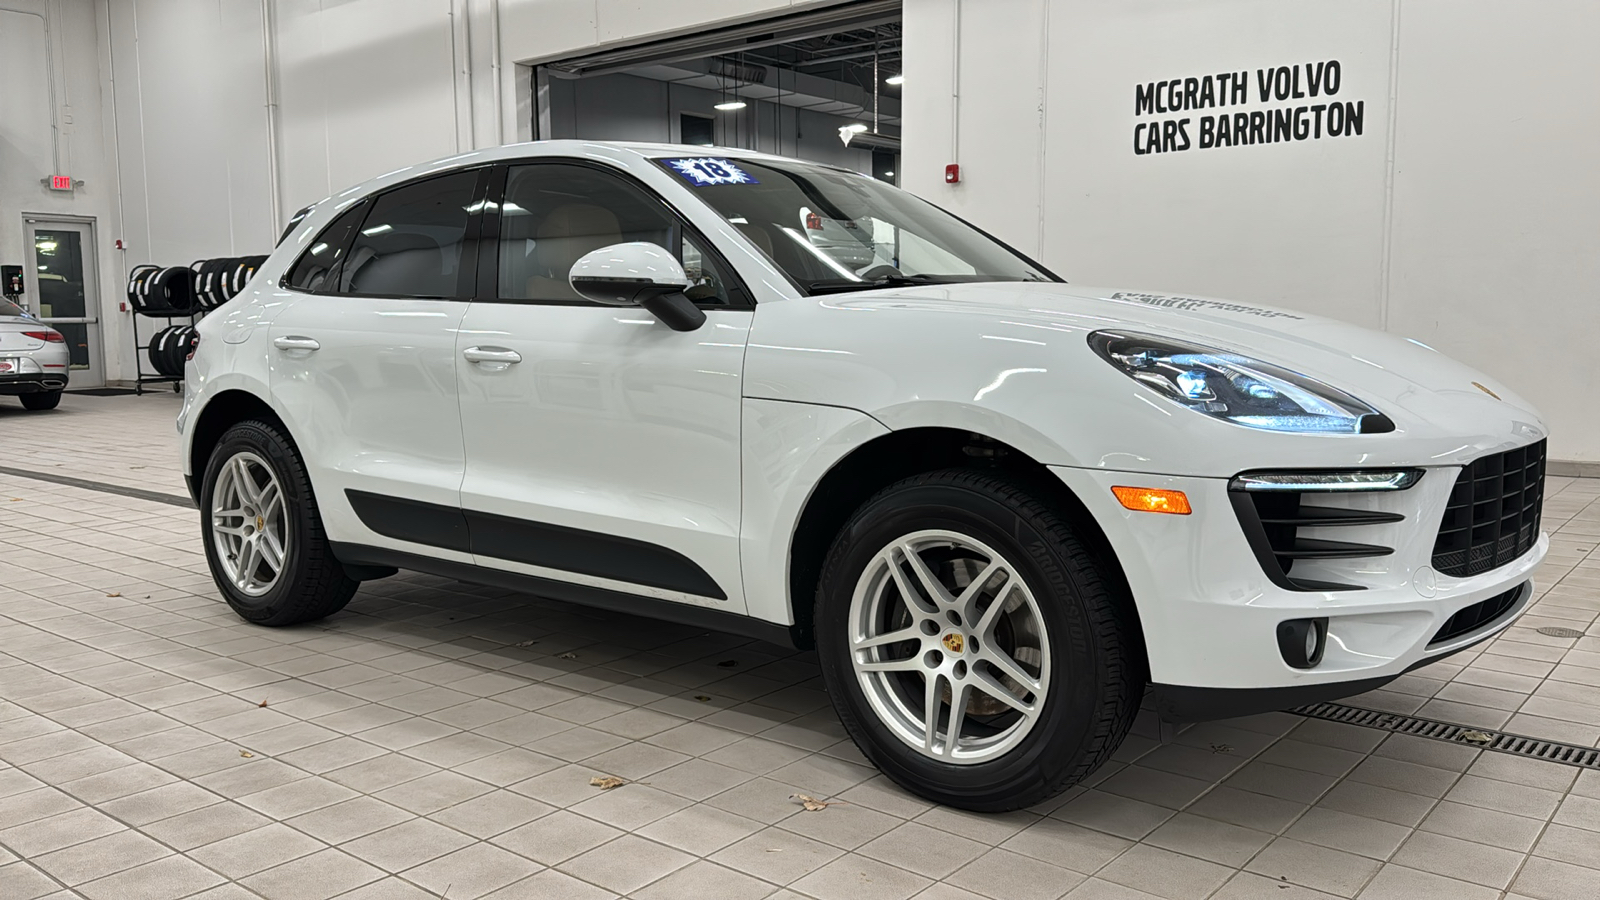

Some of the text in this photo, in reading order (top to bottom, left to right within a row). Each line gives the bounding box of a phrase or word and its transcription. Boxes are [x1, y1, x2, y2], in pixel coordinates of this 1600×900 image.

[1135, 60, 1341, 116] MCGRATH VOLVO
[1133, 100, 1364, 155] CARS BARRINGTON
[53, 175, 70, 189] EXIT
[693, 163, 731, 178] 18
[1026, 540, 1087, 657] BRIDGESTON
